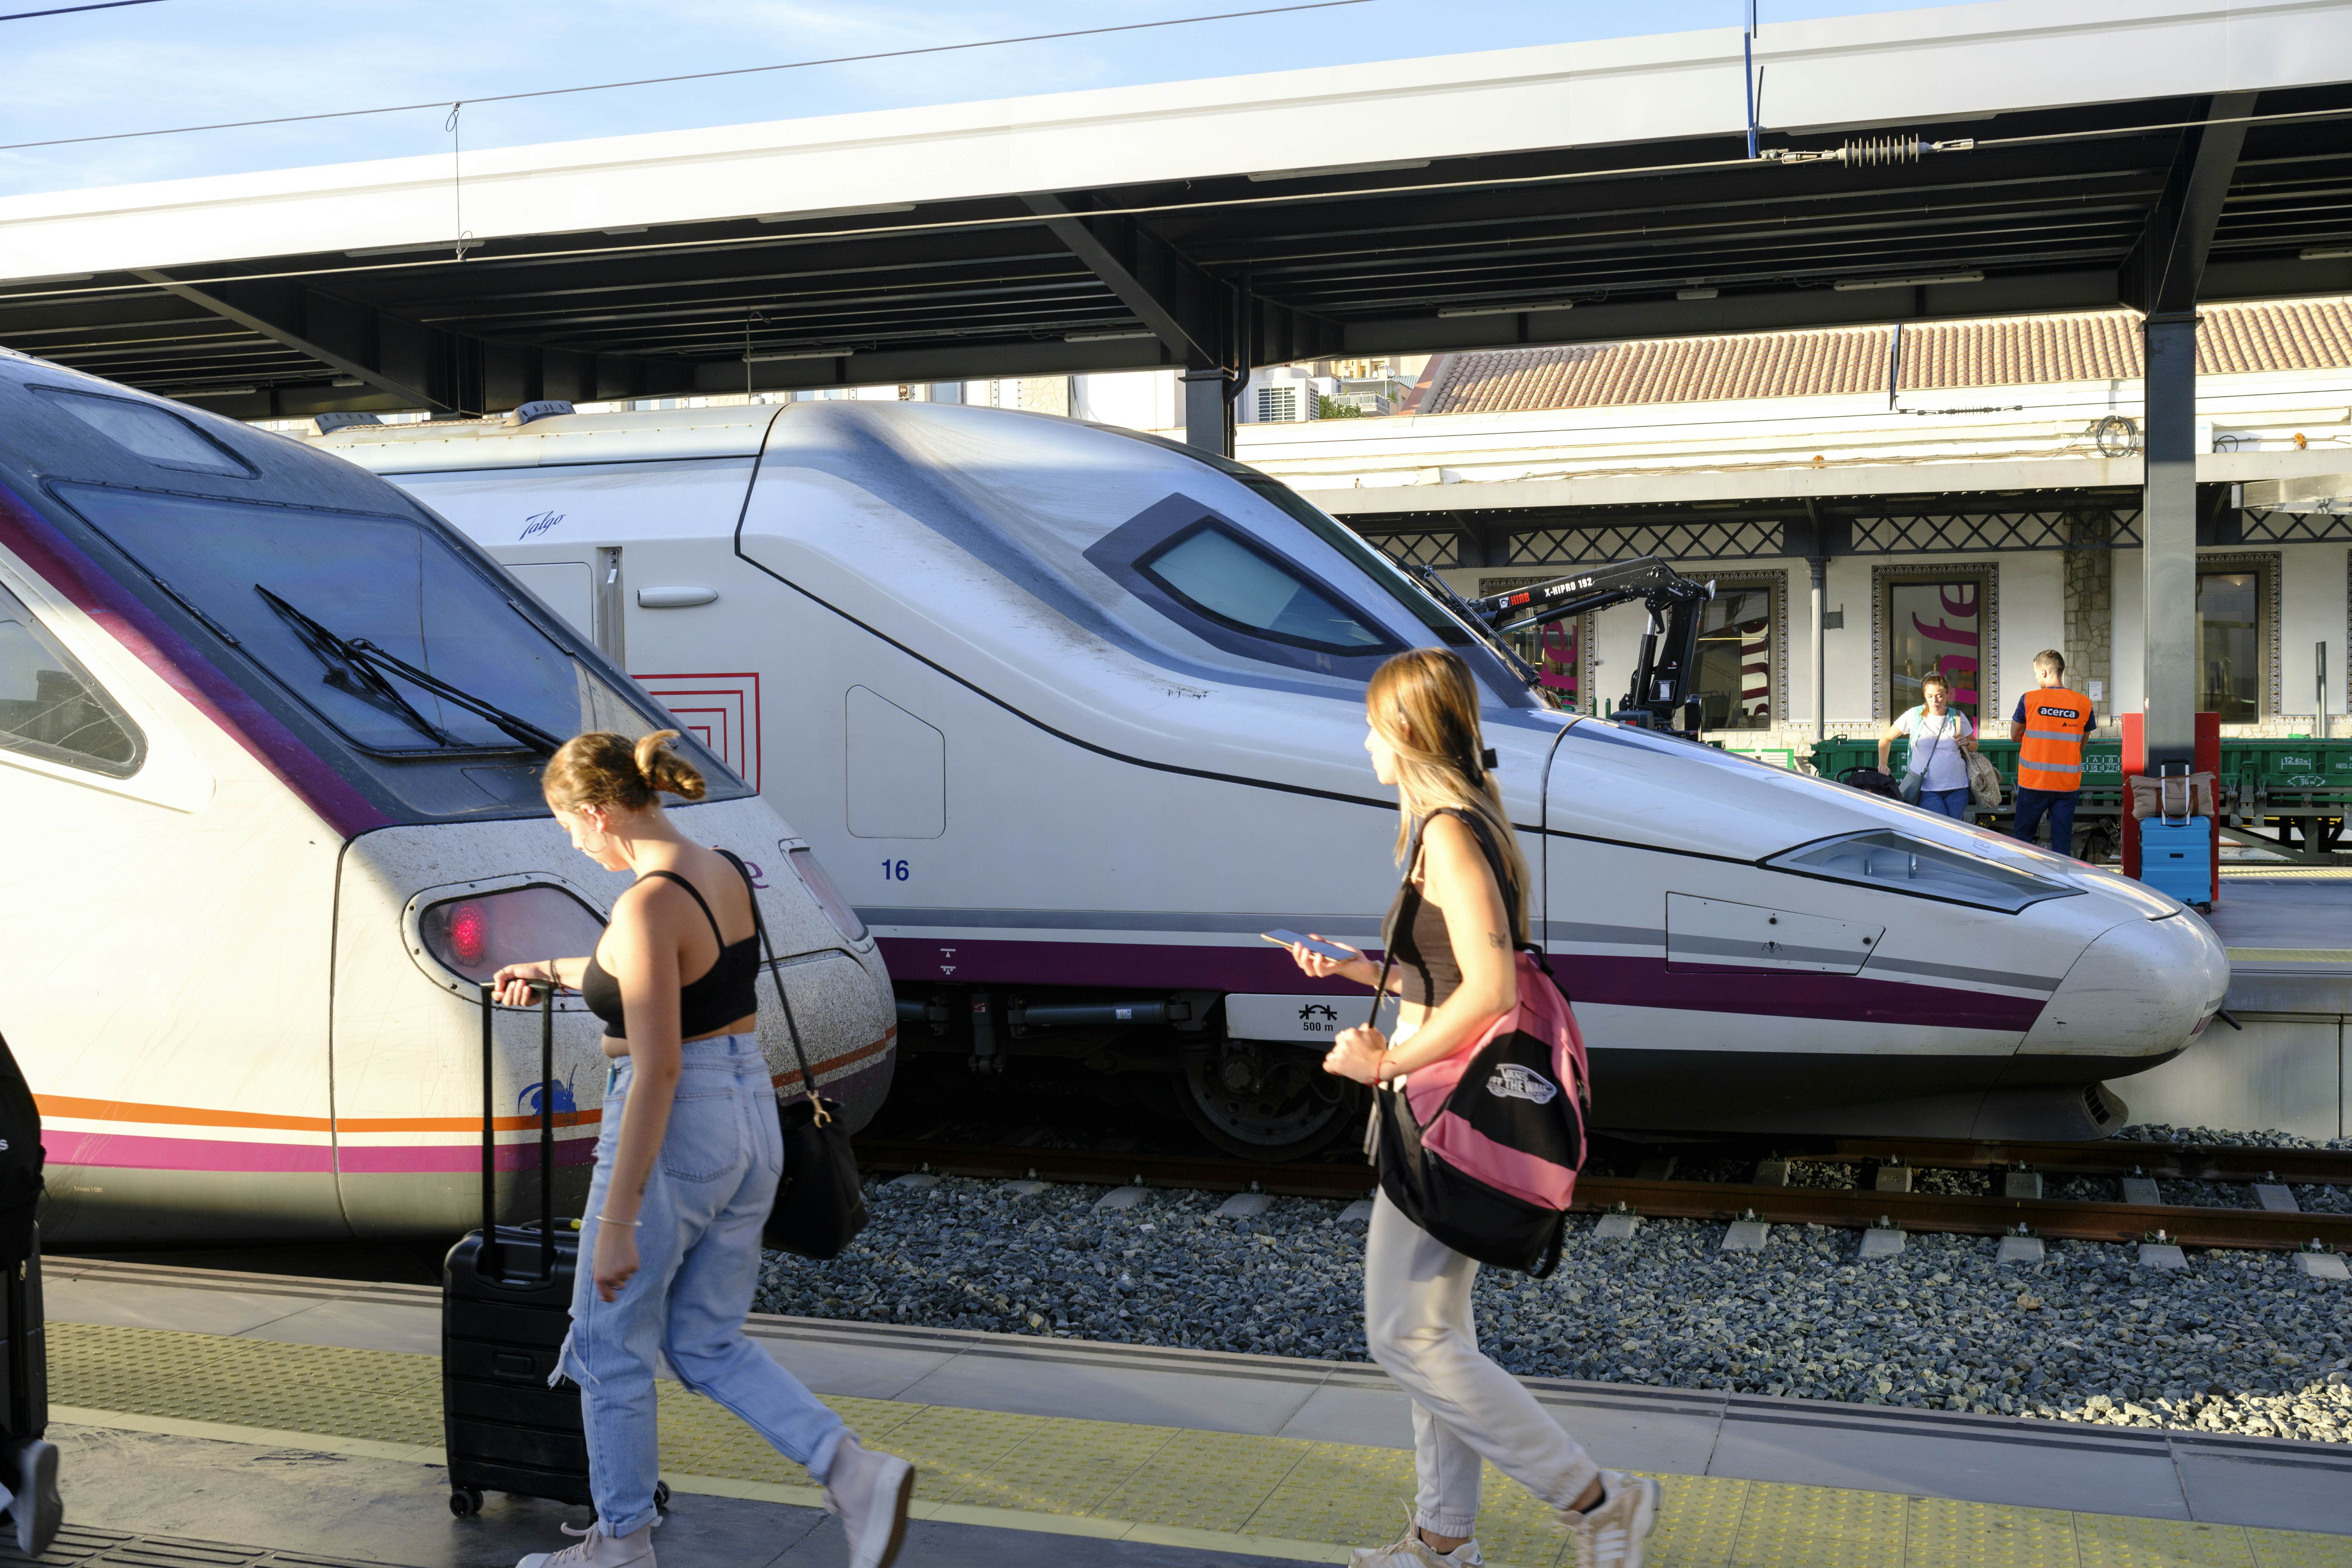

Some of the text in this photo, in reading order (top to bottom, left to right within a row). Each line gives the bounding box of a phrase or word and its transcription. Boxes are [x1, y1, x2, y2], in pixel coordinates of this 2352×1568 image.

[519, 510, 566, 541] Talgo
[1544, 577, 1593, 597] X-HIPRO 192
[1510, 592, 1530, 606] HIAB
[2041, 707, 2075, 718] acerca
[882, 859, 909, 881] 16
[1303, 1022, 1321, 1031] 500
[1495, 1067, 1529, 1081] VANS
[1504, 1078, 1524, 1092] THE
